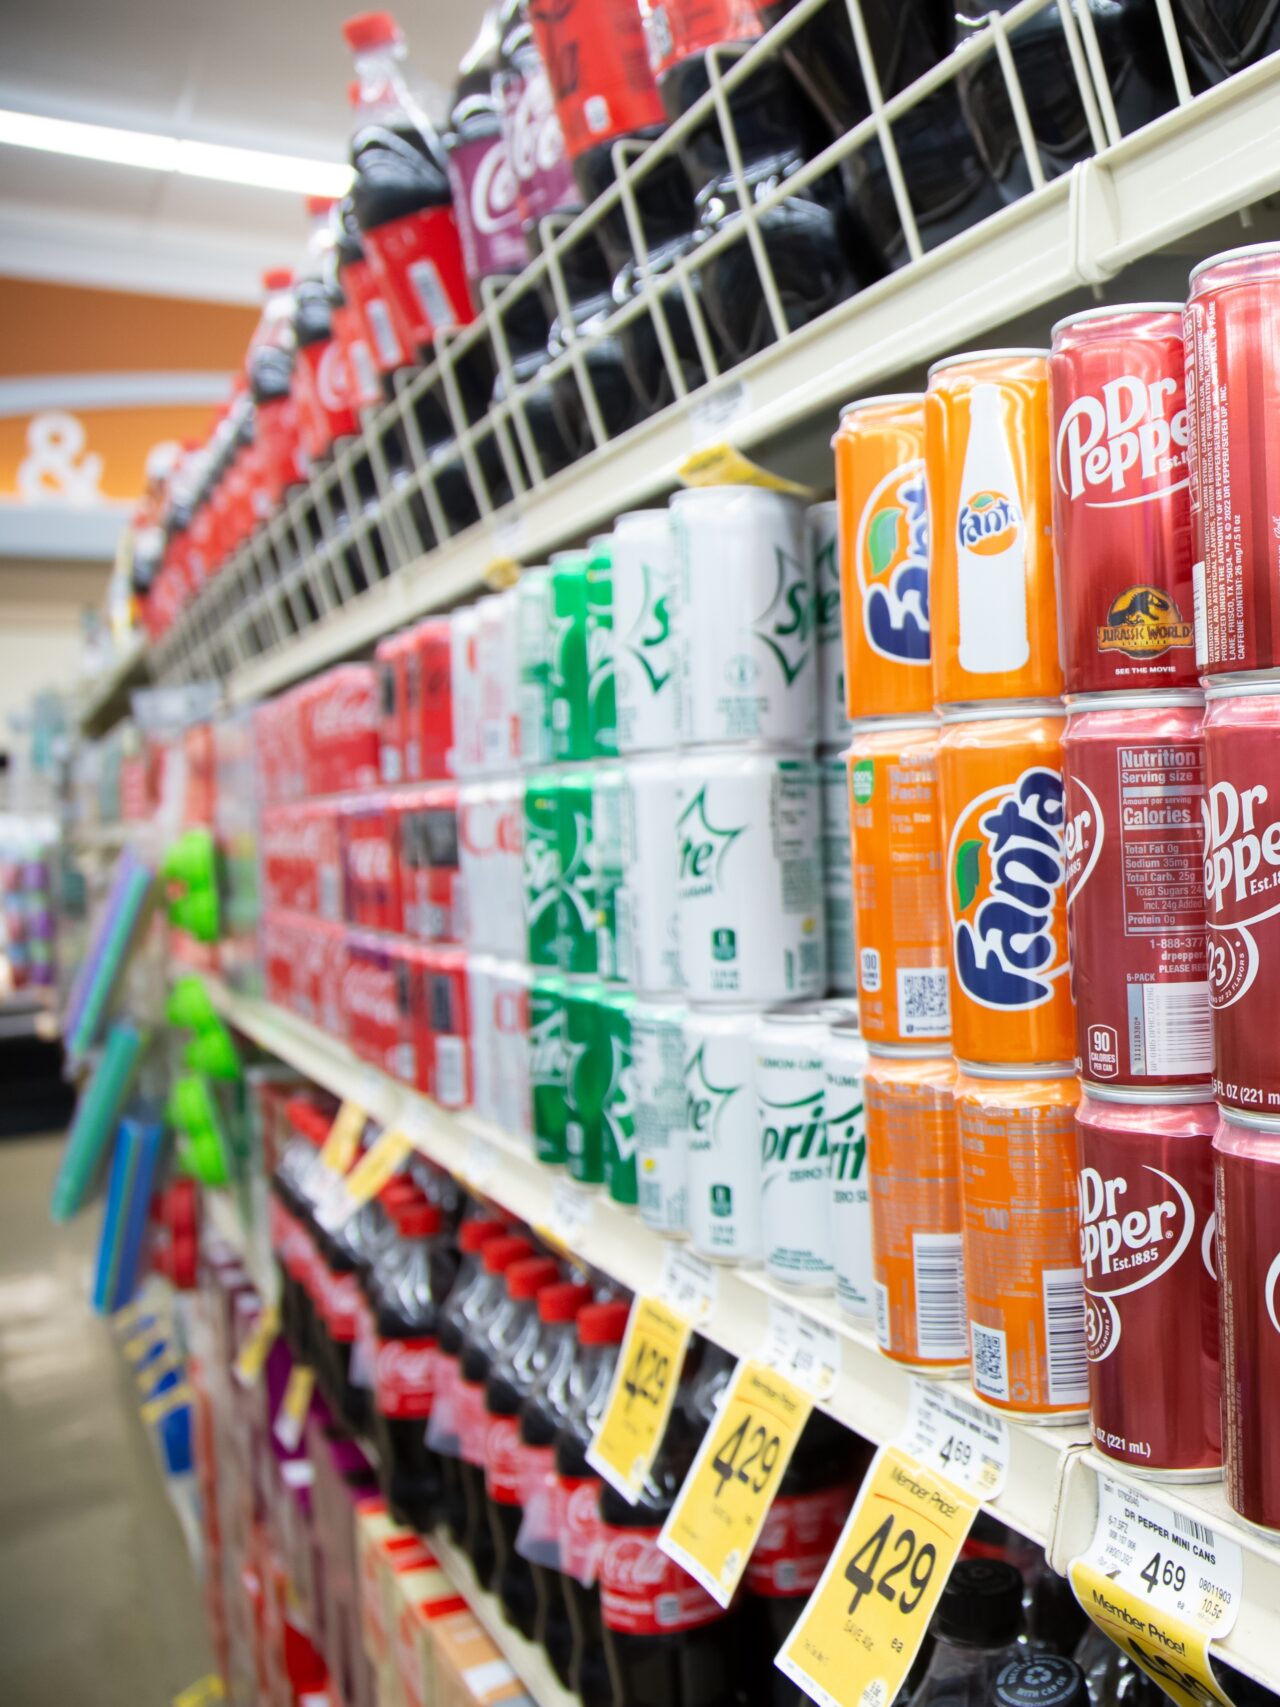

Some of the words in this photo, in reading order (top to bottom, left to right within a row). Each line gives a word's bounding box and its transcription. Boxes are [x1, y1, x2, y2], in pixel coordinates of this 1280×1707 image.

[1102, 375, 1177, 443] Dr
[1057, 395, 1189, 502] Peppe
[1213, 422, 1222, 486] PEPPER/SEVEN
[1220, 419, 1230, 484] PEPPER/SEVEN
[1216, 489, 1222, 501] DR
[1223, 486, 1230, 498] DR
[1216, 503, 1222, 514] OF
[1234, 514, 1240, 524] oz
[957, 496, 1020, 544] Fanta
[1234, 534, 1243, 564] mg/7.5
[1235, 566, 1242, 576] 26
[1226, 586, 1234, 596] TX
[1236, 578, 1244, 618] CONTENT:
[1227, 598, 1235, 632] FRISCO,
[1102, 627, 1145, 642] JURASSIC
[1147, 625, 1190, 640] WORLD
[1237, 618, 1245, 660] CAFFEINE
[1122, 748, 1196, 768] Nutrition
[1122, 771, 1166, 784] Serving
[1169, 770, 1193, 781] size
[1123, 806, 1191, 826] Calories
[1209, 781, 1268, 850] Dr
[1125, 845, 1148, 854] Total
[1150, 844, 1165, 853] Fat
[1167, 844, 1179, 855] 0g
[1125, 859, 1160, 868] Sodium
[1163, 858, 1189, 868] 35mg
[954, 770, 1064, 1005] Fanta
[1126, 873, 1148, 882] Total
[1150, 872, 1175, 882] Carb.
[1178, 872, 1195, 882] 25g
[1135, 887, 1156, 896] Total
[1158, 886, 1189, 897] Sugars
[1144, 902, 1159, 910] Incl.
[1162, 902, 1177, 910] 24g
[1128, 915, 1161, 924] Protein
[1164, 915, 1176, 925] 0g
[1126, 972, 1156, 982] 6-PACK
[1158, 964, 1190, 974] PLEASE
[1093, 1031, 1110, 1053] 90
[1090, 1052, 1116, 1064] CALORIES
[1093, 1063, 1102, 1071] PER
[1226, 1083, 1238, 1100] OZ
[1240, 1086, 1263, 1104] (221
[1080, 1167, 1127, 1224] Dr
[1112, 1248, 1159, 1272] Est.1885
[711, 1413, 781, 1498] 429
[1106, 1432, 1126, 1451] (221
[1128, 1441, 1152, 1458] mL)
[890, 1466, 928, 1501] Member
[930, 1490, 959, 1519] Price!
[1124, 1508, 1136, 1521] DR
[1138, 1515, 1170, 1540] PEPPER
[1172, 1534, 1191, 1552] MINI
[1192, 1545, 1217, 1566] CANS
[844, 1513, 938, 1615] 429
[1198, 1577, 1232, 1604] 08011903
[1176, 1600, 1185, 1610] ea
[1201, 1598, 1223, 1620] 10.5¢
[1092, 1588, 1145, 1632] Member
[1148, 1622, 1186, 1657] Price!
[890, 1637, 904, 1654] ea
